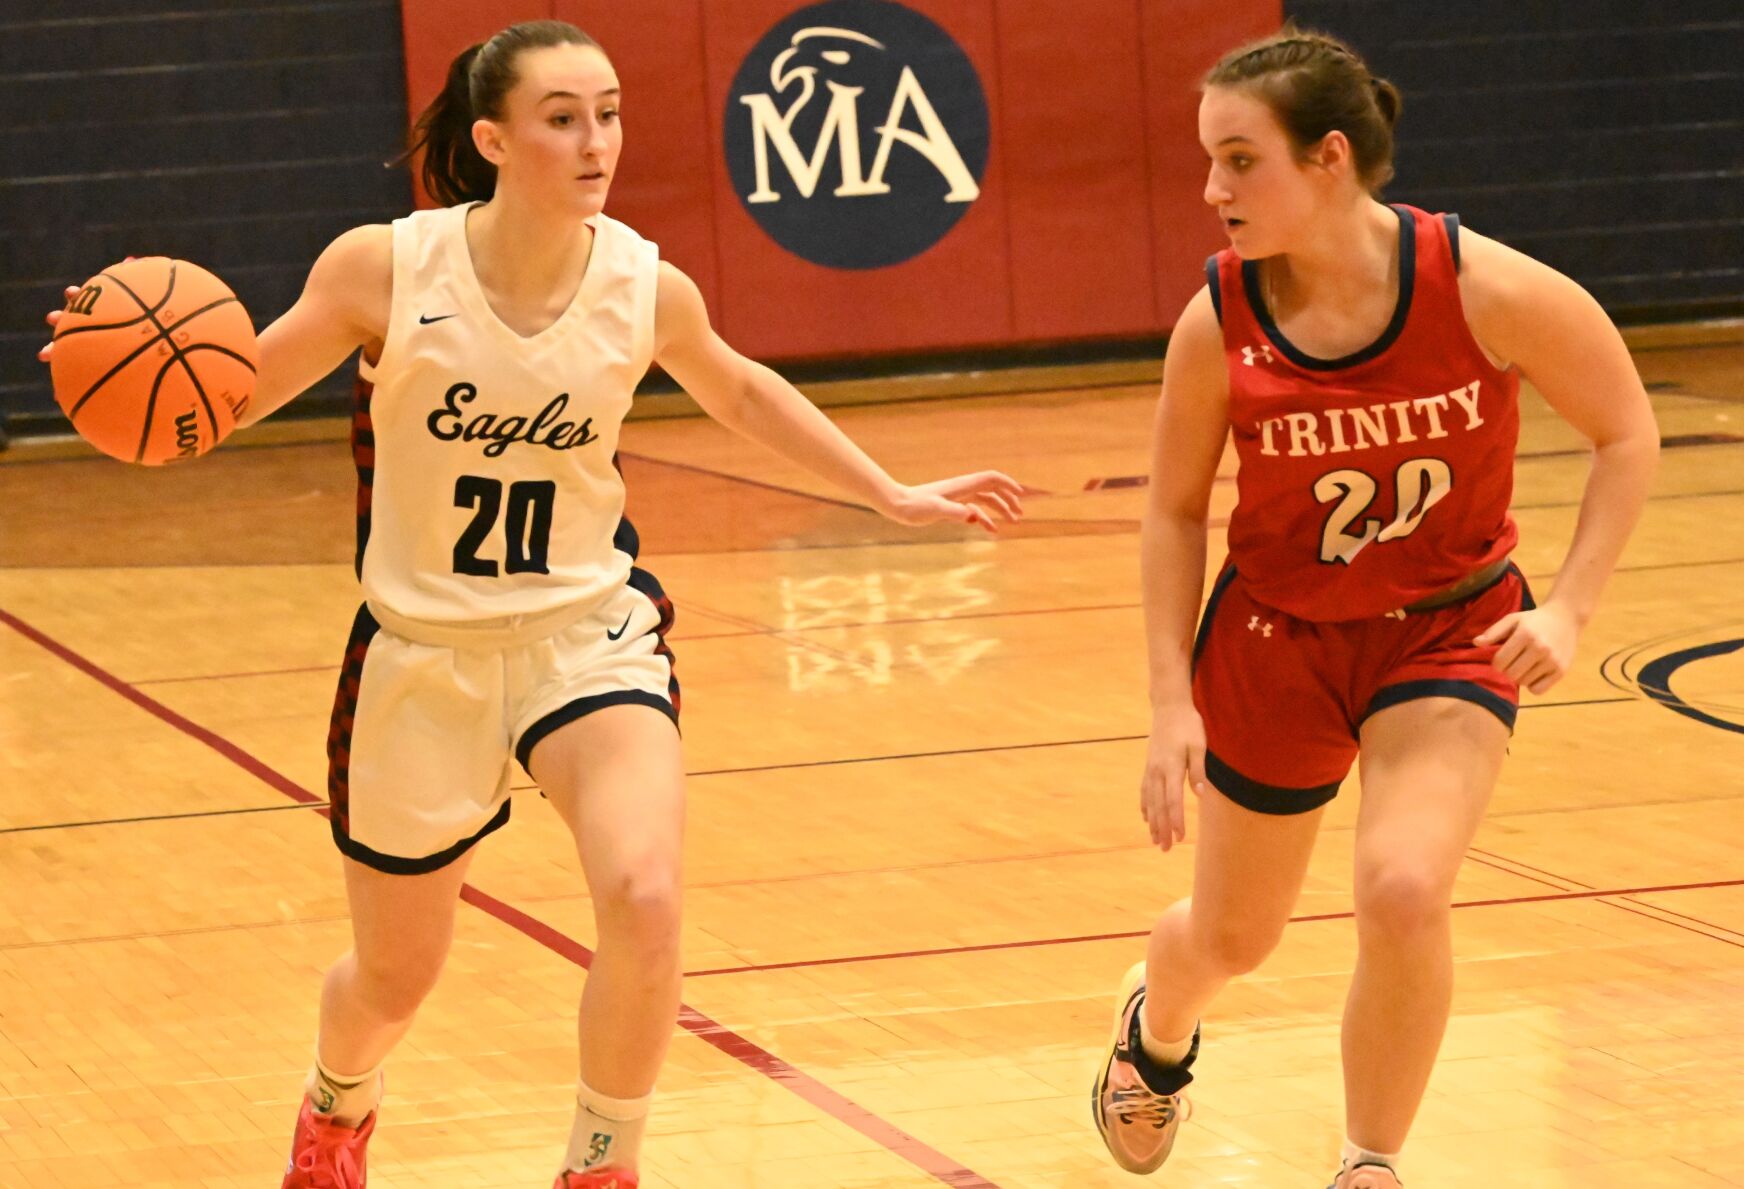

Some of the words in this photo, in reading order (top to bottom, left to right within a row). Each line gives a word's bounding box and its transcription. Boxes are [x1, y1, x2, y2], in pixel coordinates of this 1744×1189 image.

[739, 65, 980, 203] MA
[427, 382, 599, 457] Eagles
[1255, 380, 1485, 457] TRINITY
[452, 474, 556, 578] 20
[1312, 457, 1454, 566] 20
